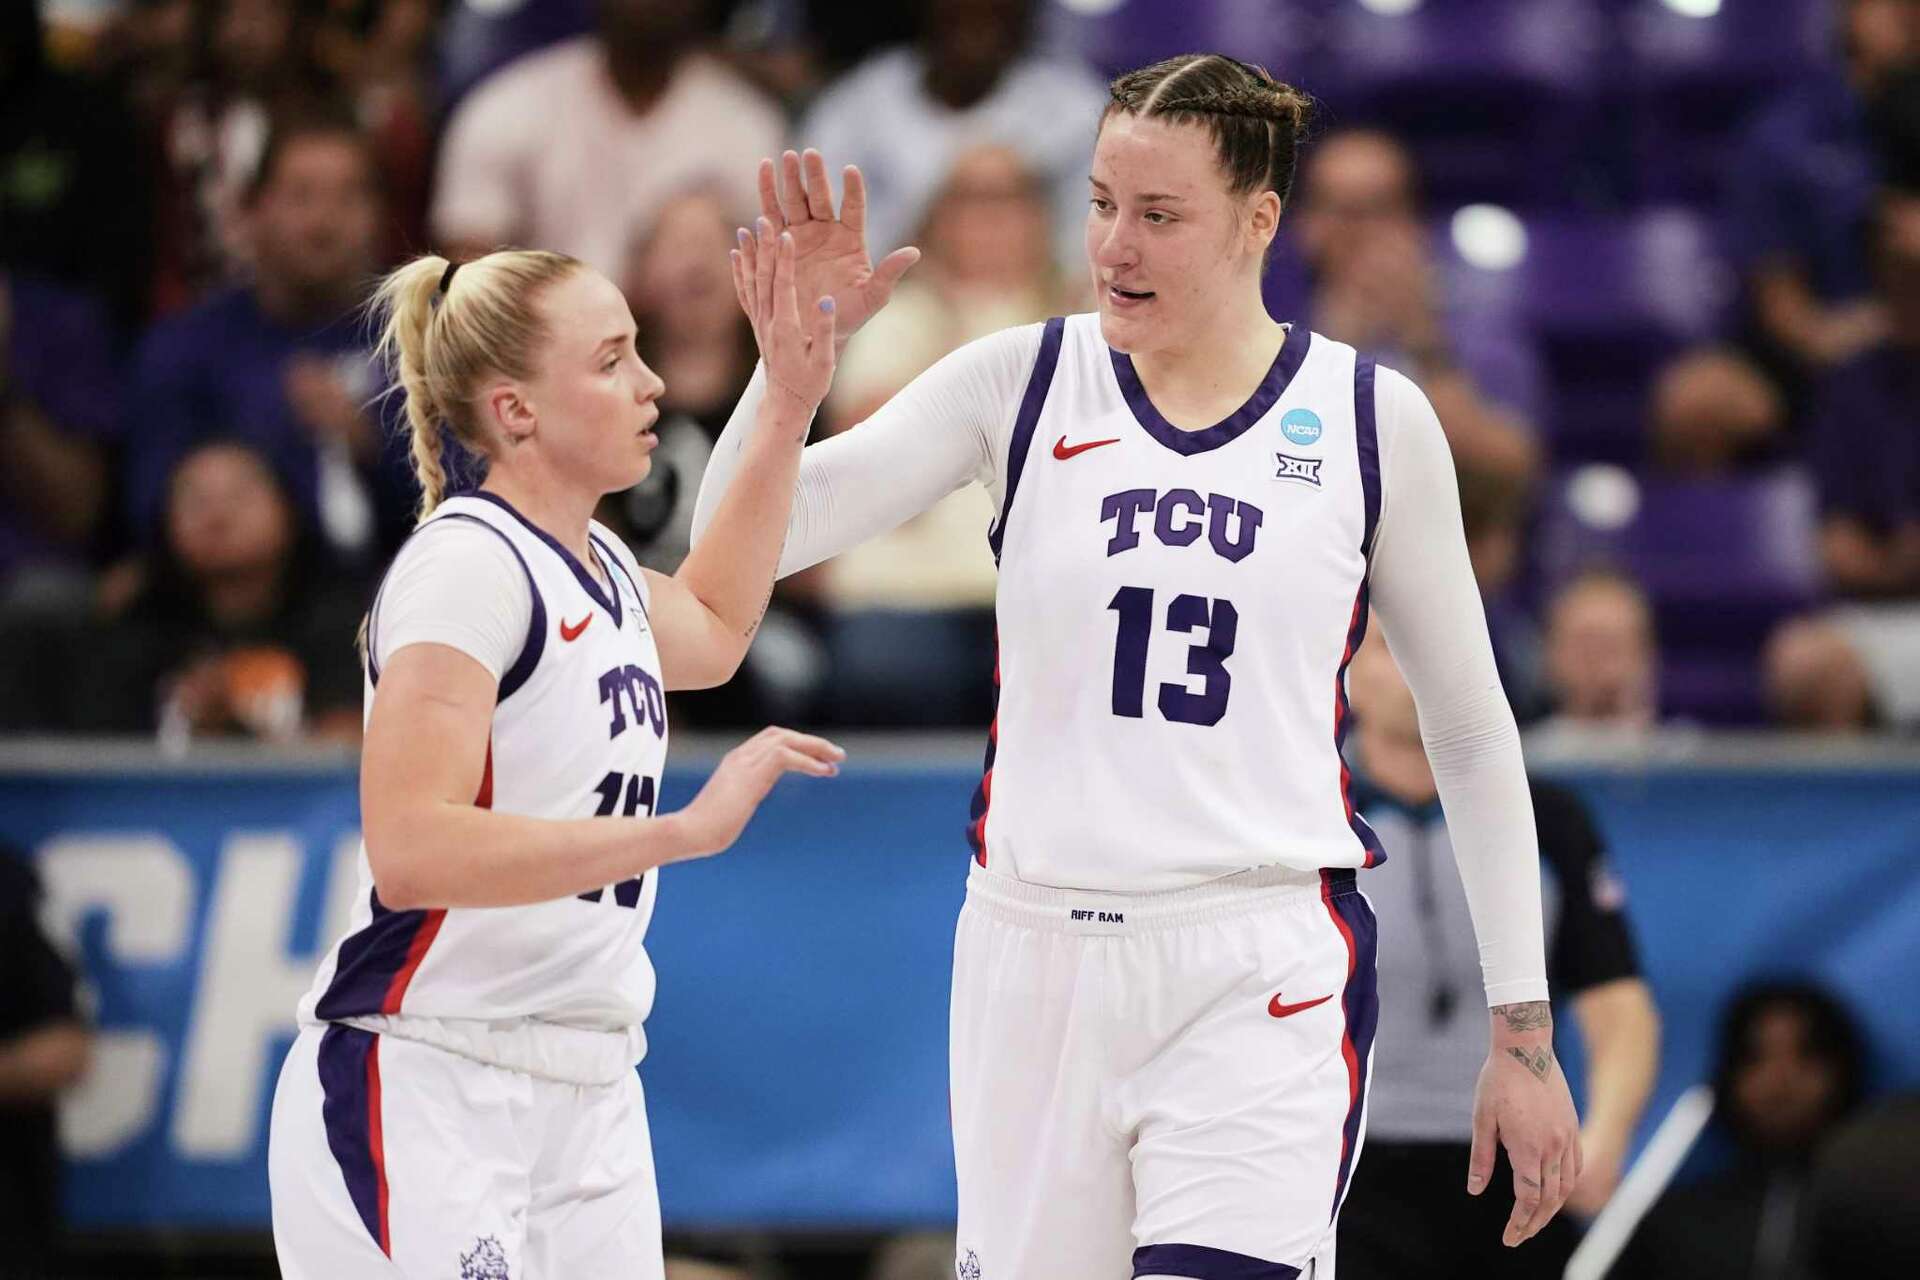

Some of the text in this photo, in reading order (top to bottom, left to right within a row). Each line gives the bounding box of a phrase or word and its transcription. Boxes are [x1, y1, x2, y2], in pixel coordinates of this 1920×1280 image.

[1286, 423, 1320, 438] NCAA
[1100, 488, 1264, 564] TCU
[1106, 586, 1239, 728] 13
[598, 664, 666, 740] TCU
[1071, 909, 1124, 924] RIFF RAM
